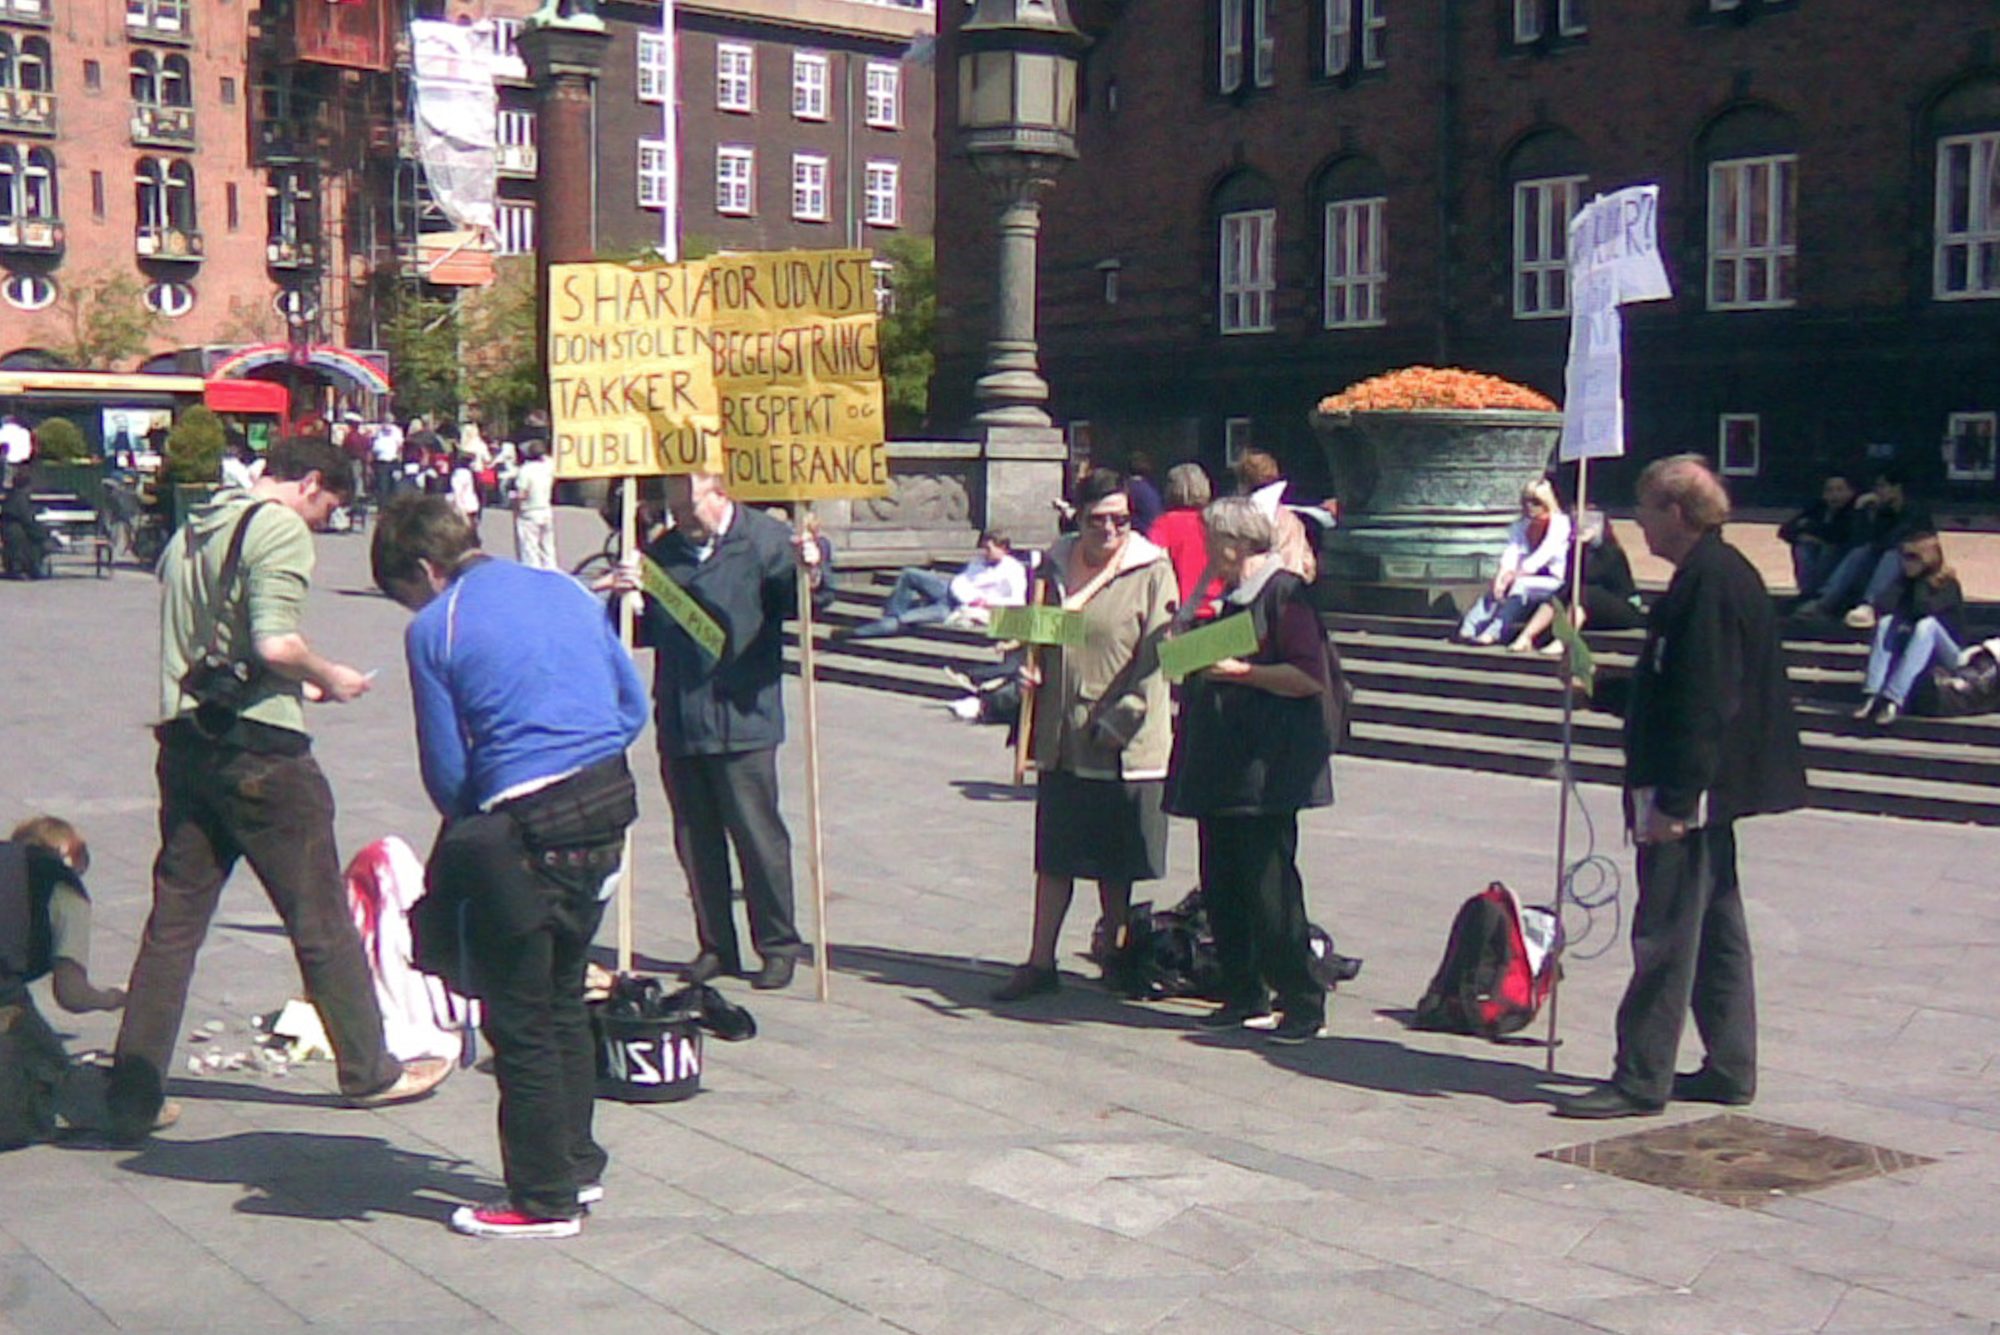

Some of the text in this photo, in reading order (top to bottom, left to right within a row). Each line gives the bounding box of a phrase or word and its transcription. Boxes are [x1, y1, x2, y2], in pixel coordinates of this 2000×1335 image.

[562, 270, 713, 324] SHARIA
[709, 254, 869, 311] FOR UDVIST
[553, 326, 716, 365] DOMSTOLEN
[554, 371, 698, 418] TAKKER
[722, 394, 875, 437] RESPEKT OG
[556, 424, 723, 472] PUBLIKUM
[725, 442, 886, 486] TOLERANCE
